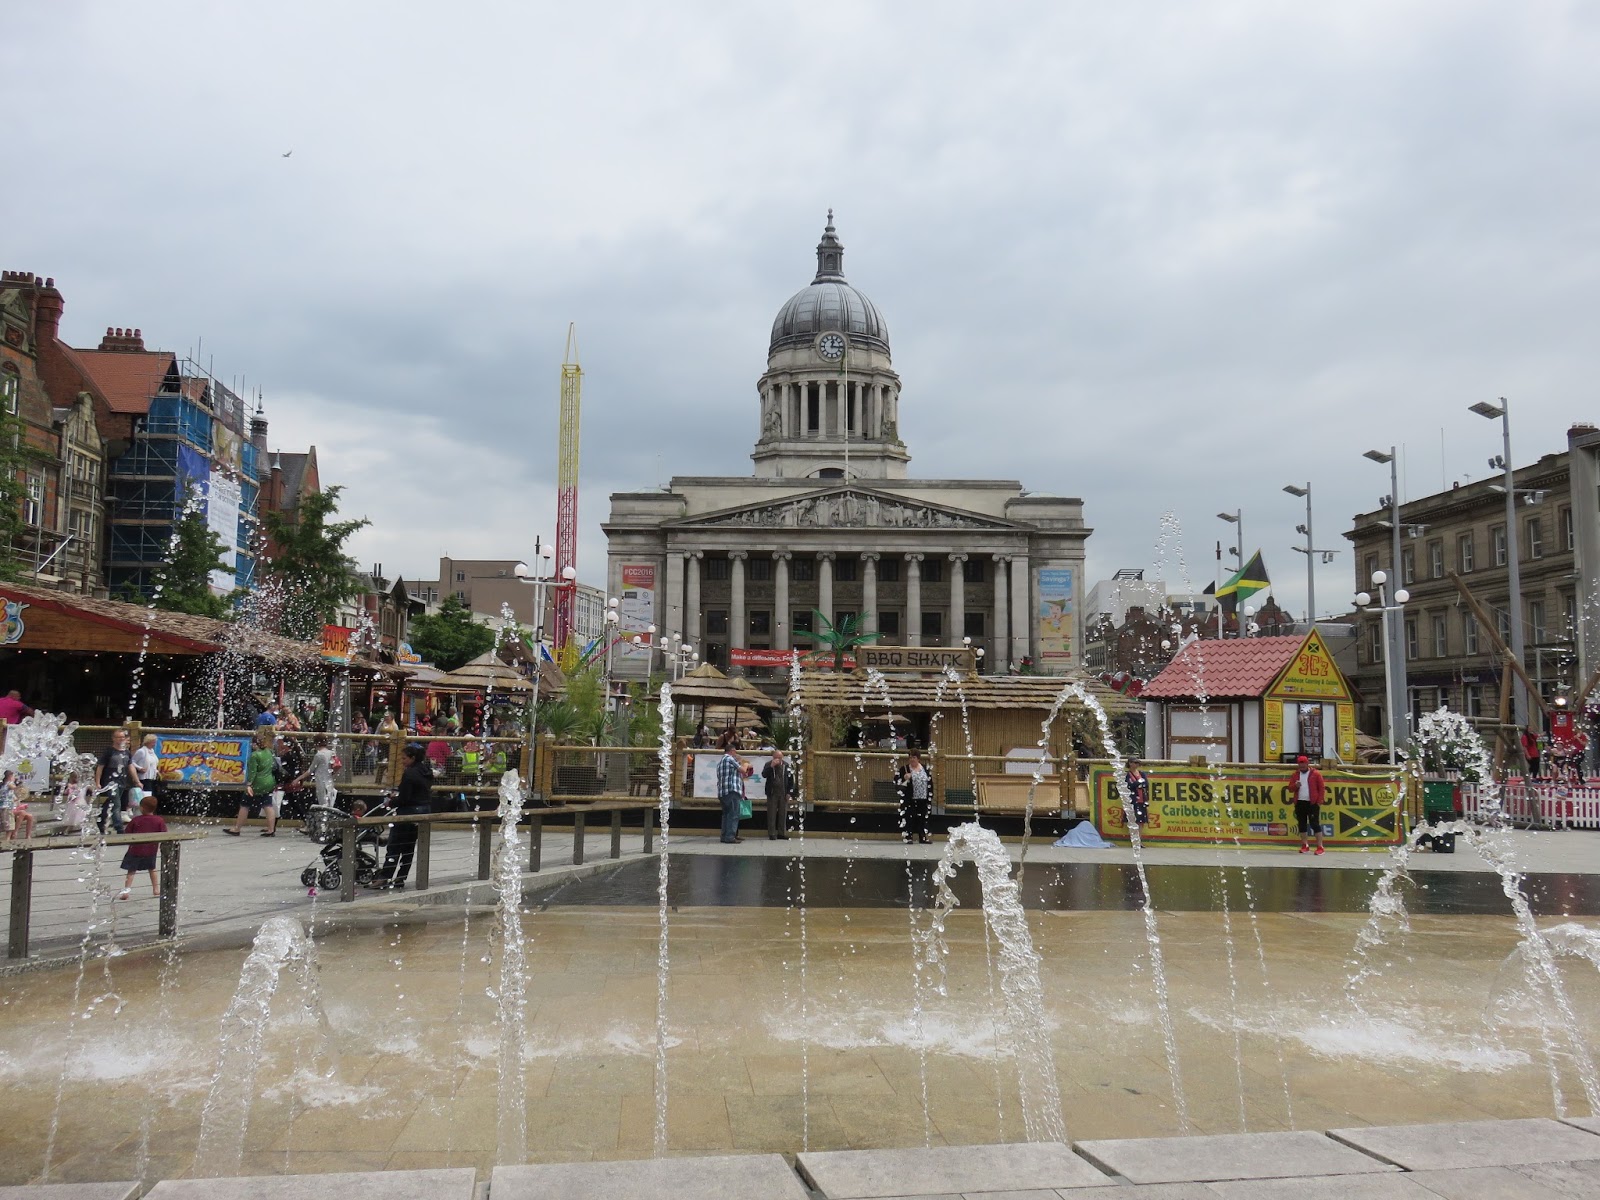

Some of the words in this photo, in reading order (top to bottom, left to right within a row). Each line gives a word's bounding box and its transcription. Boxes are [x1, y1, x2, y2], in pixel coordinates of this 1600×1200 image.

[866, 652, 903, 666] BBQ
[907, 652, 963, 667] SHACK
[161, 740, 242, 757] TRADITIONAL
[158, 756, 187, 773] FISH
[204, 756, 245, 776] CHIPS
[1107, 781, 1213, 802] BELESS
[1221, 783, 1274, 805] JERK
[1281, 786, 1374, 807] CCKEN
[1162, 805, 1220, 818] Caribbean
[1278, 808, 1287, 820] &
